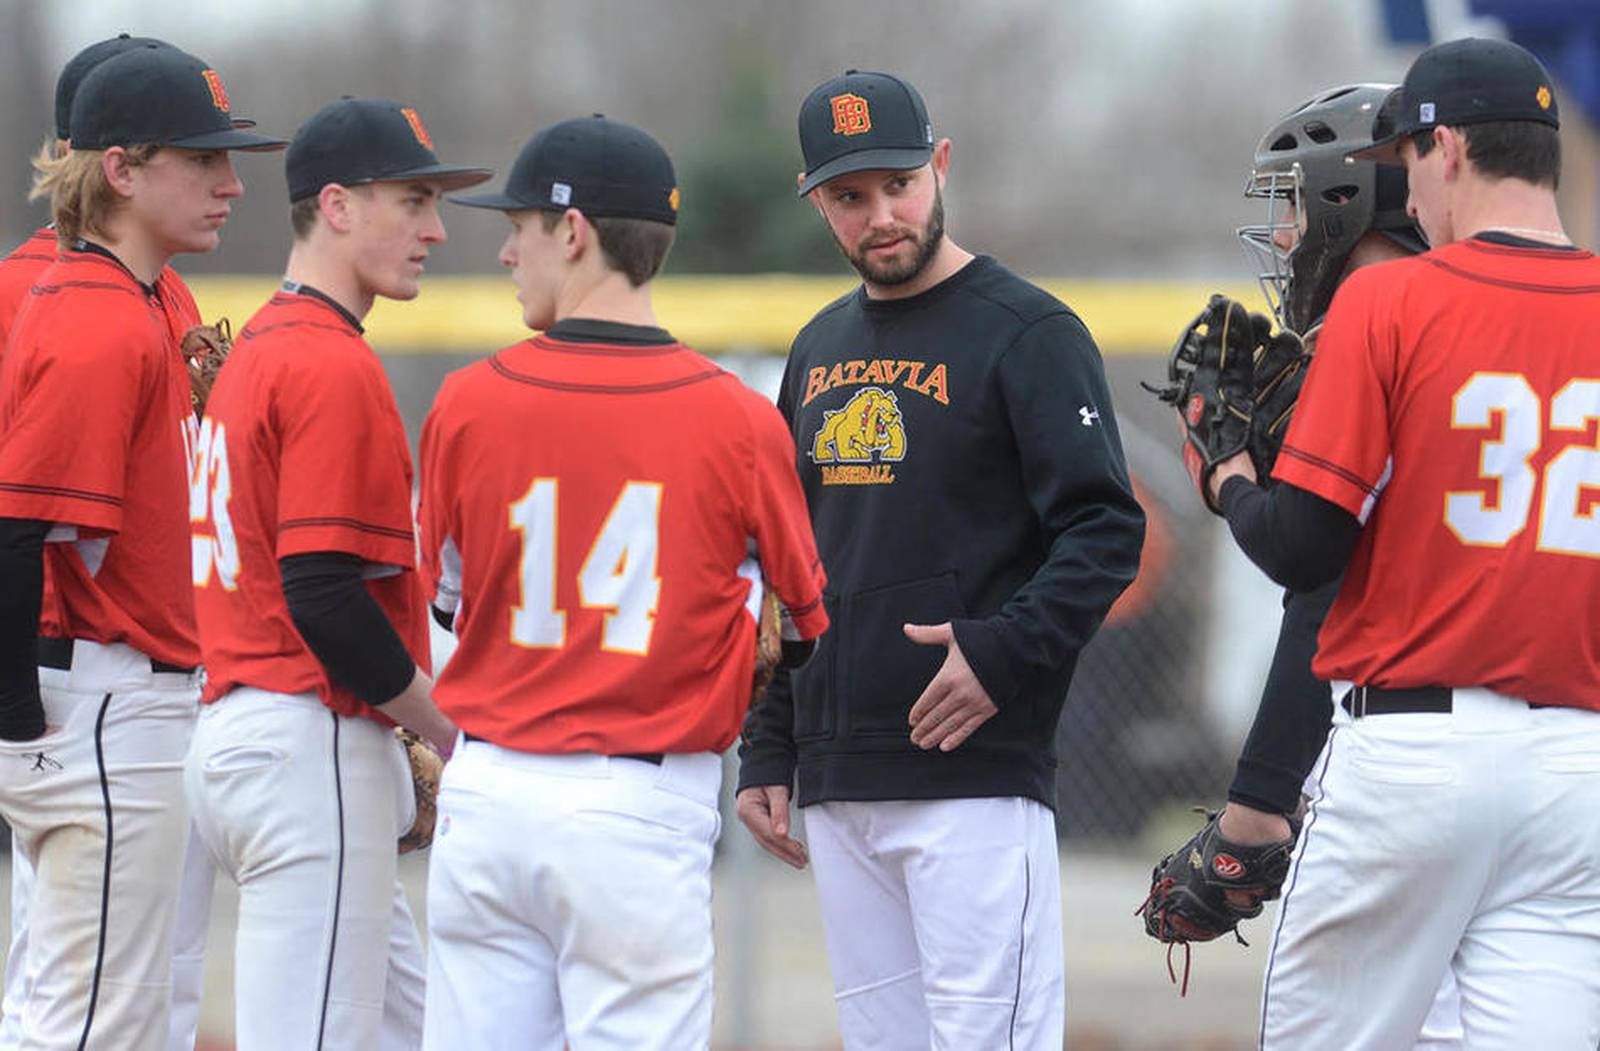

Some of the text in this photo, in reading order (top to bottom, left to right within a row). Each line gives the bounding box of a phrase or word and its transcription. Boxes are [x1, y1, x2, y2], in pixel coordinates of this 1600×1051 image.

[801, 360, 949, 407] BATAVIA
[821, 464, 895, 485] BASEBALL
[1443, 371, 1600, 559] 32
[508, 477, 664, 656] 14
